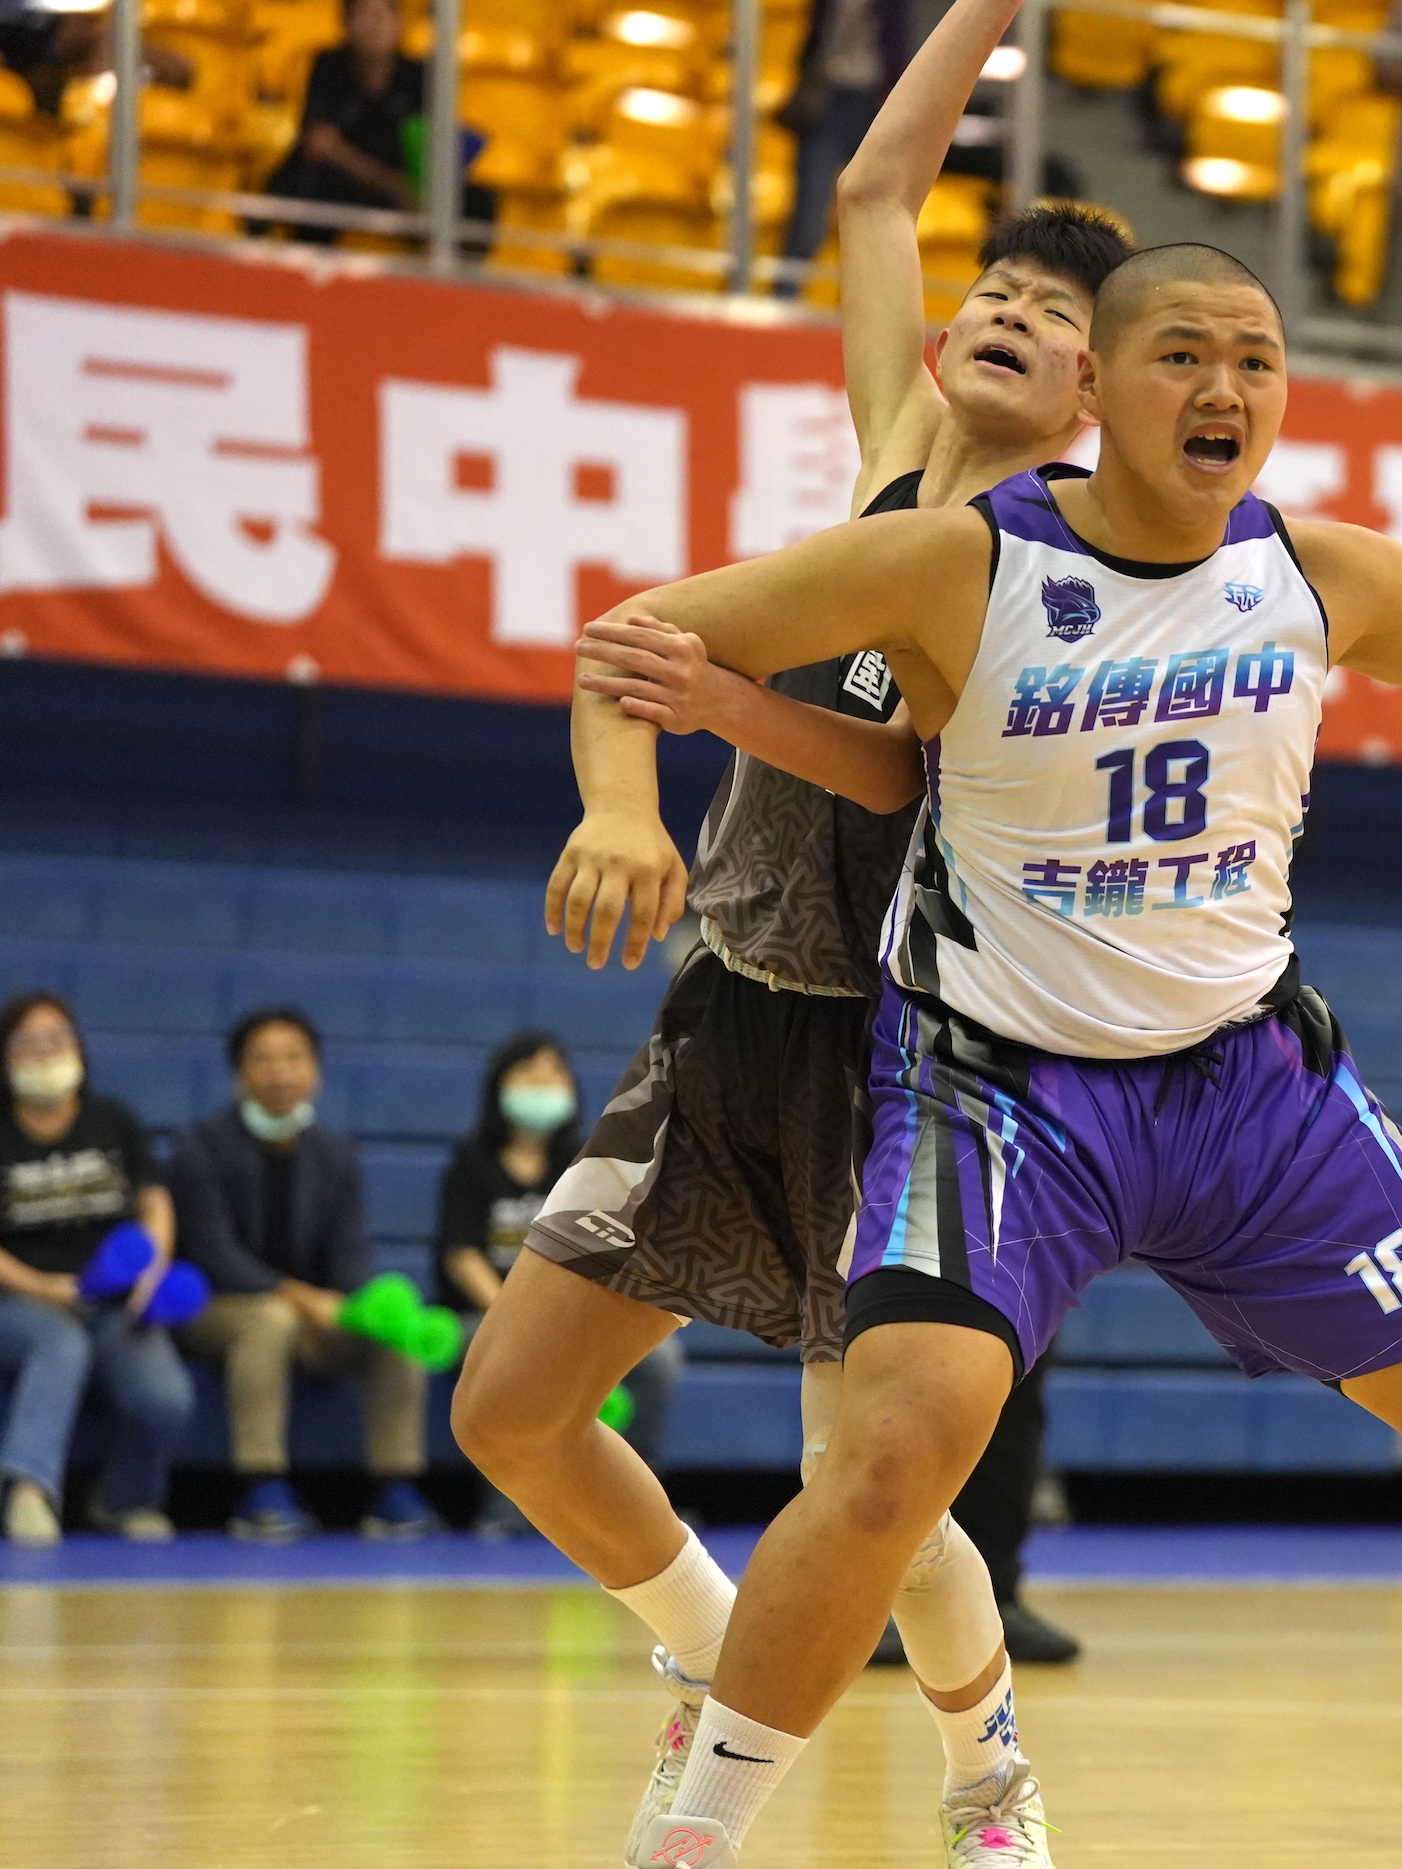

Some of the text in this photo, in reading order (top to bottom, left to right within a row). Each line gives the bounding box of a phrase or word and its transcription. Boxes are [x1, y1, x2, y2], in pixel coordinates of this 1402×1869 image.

[1048, 623, 1094, 636] MCJH
[1000, 641, 1295, 738] 銘傳國中
[1095, 738, 1211, 844] 18
